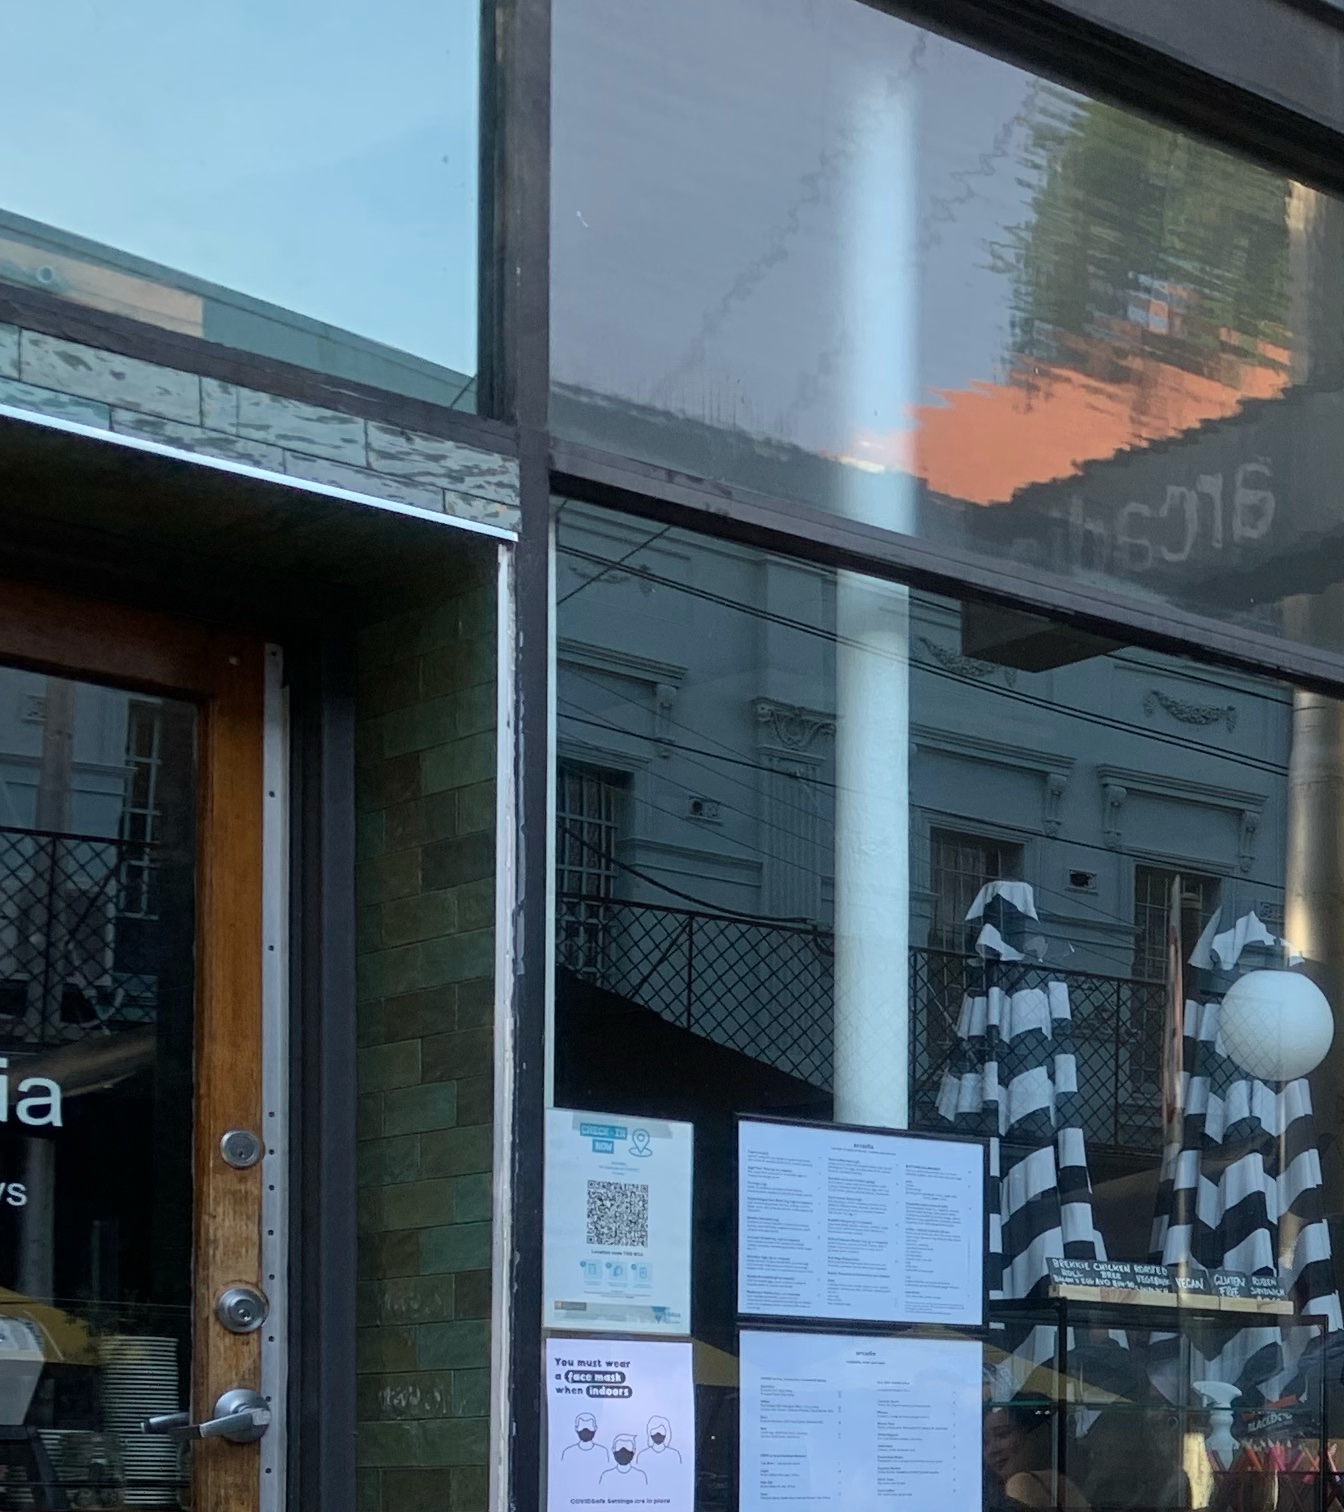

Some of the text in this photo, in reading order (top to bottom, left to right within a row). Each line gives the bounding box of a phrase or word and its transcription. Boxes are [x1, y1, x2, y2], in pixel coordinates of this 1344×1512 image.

[1093, 1262, 1131, 1273] CHICKEN
[1175, 1277, 1204, 1290] VEGAN
[1214, 1274, 1245, 1287] GLUTEN
[554, 1357, 631, 1368] You must wear
[567, 1371, 592, 1383] face
[594, 1372, 622, 1382] mask
[555, 1385, 629, 1396] when indoors
